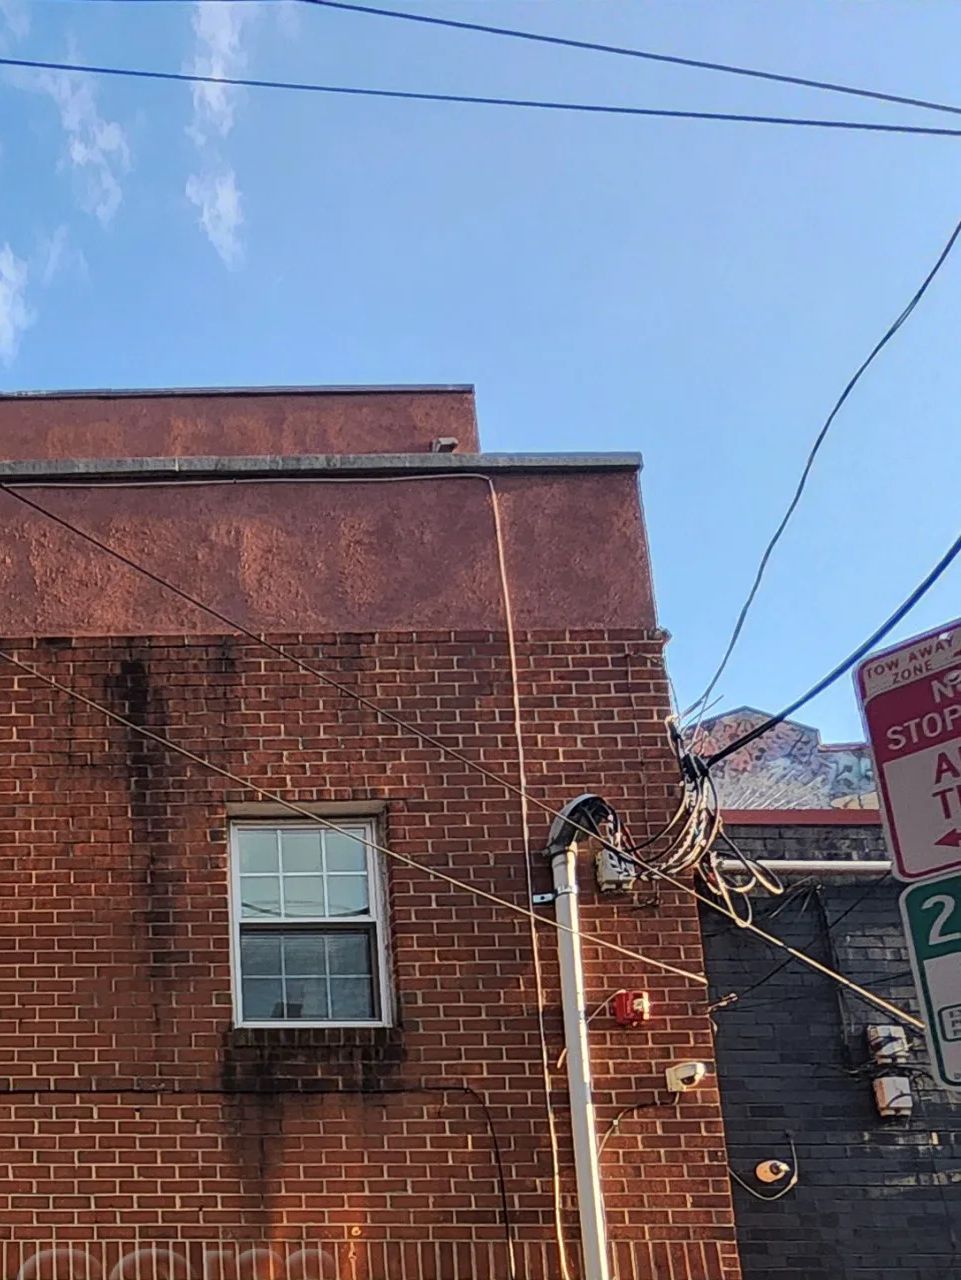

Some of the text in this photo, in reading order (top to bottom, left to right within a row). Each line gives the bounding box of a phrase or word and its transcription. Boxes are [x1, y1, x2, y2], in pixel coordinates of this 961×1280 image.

[867, 634, 954, 679] TOW AWAY
[892, 659, 932, 685] ZONE
